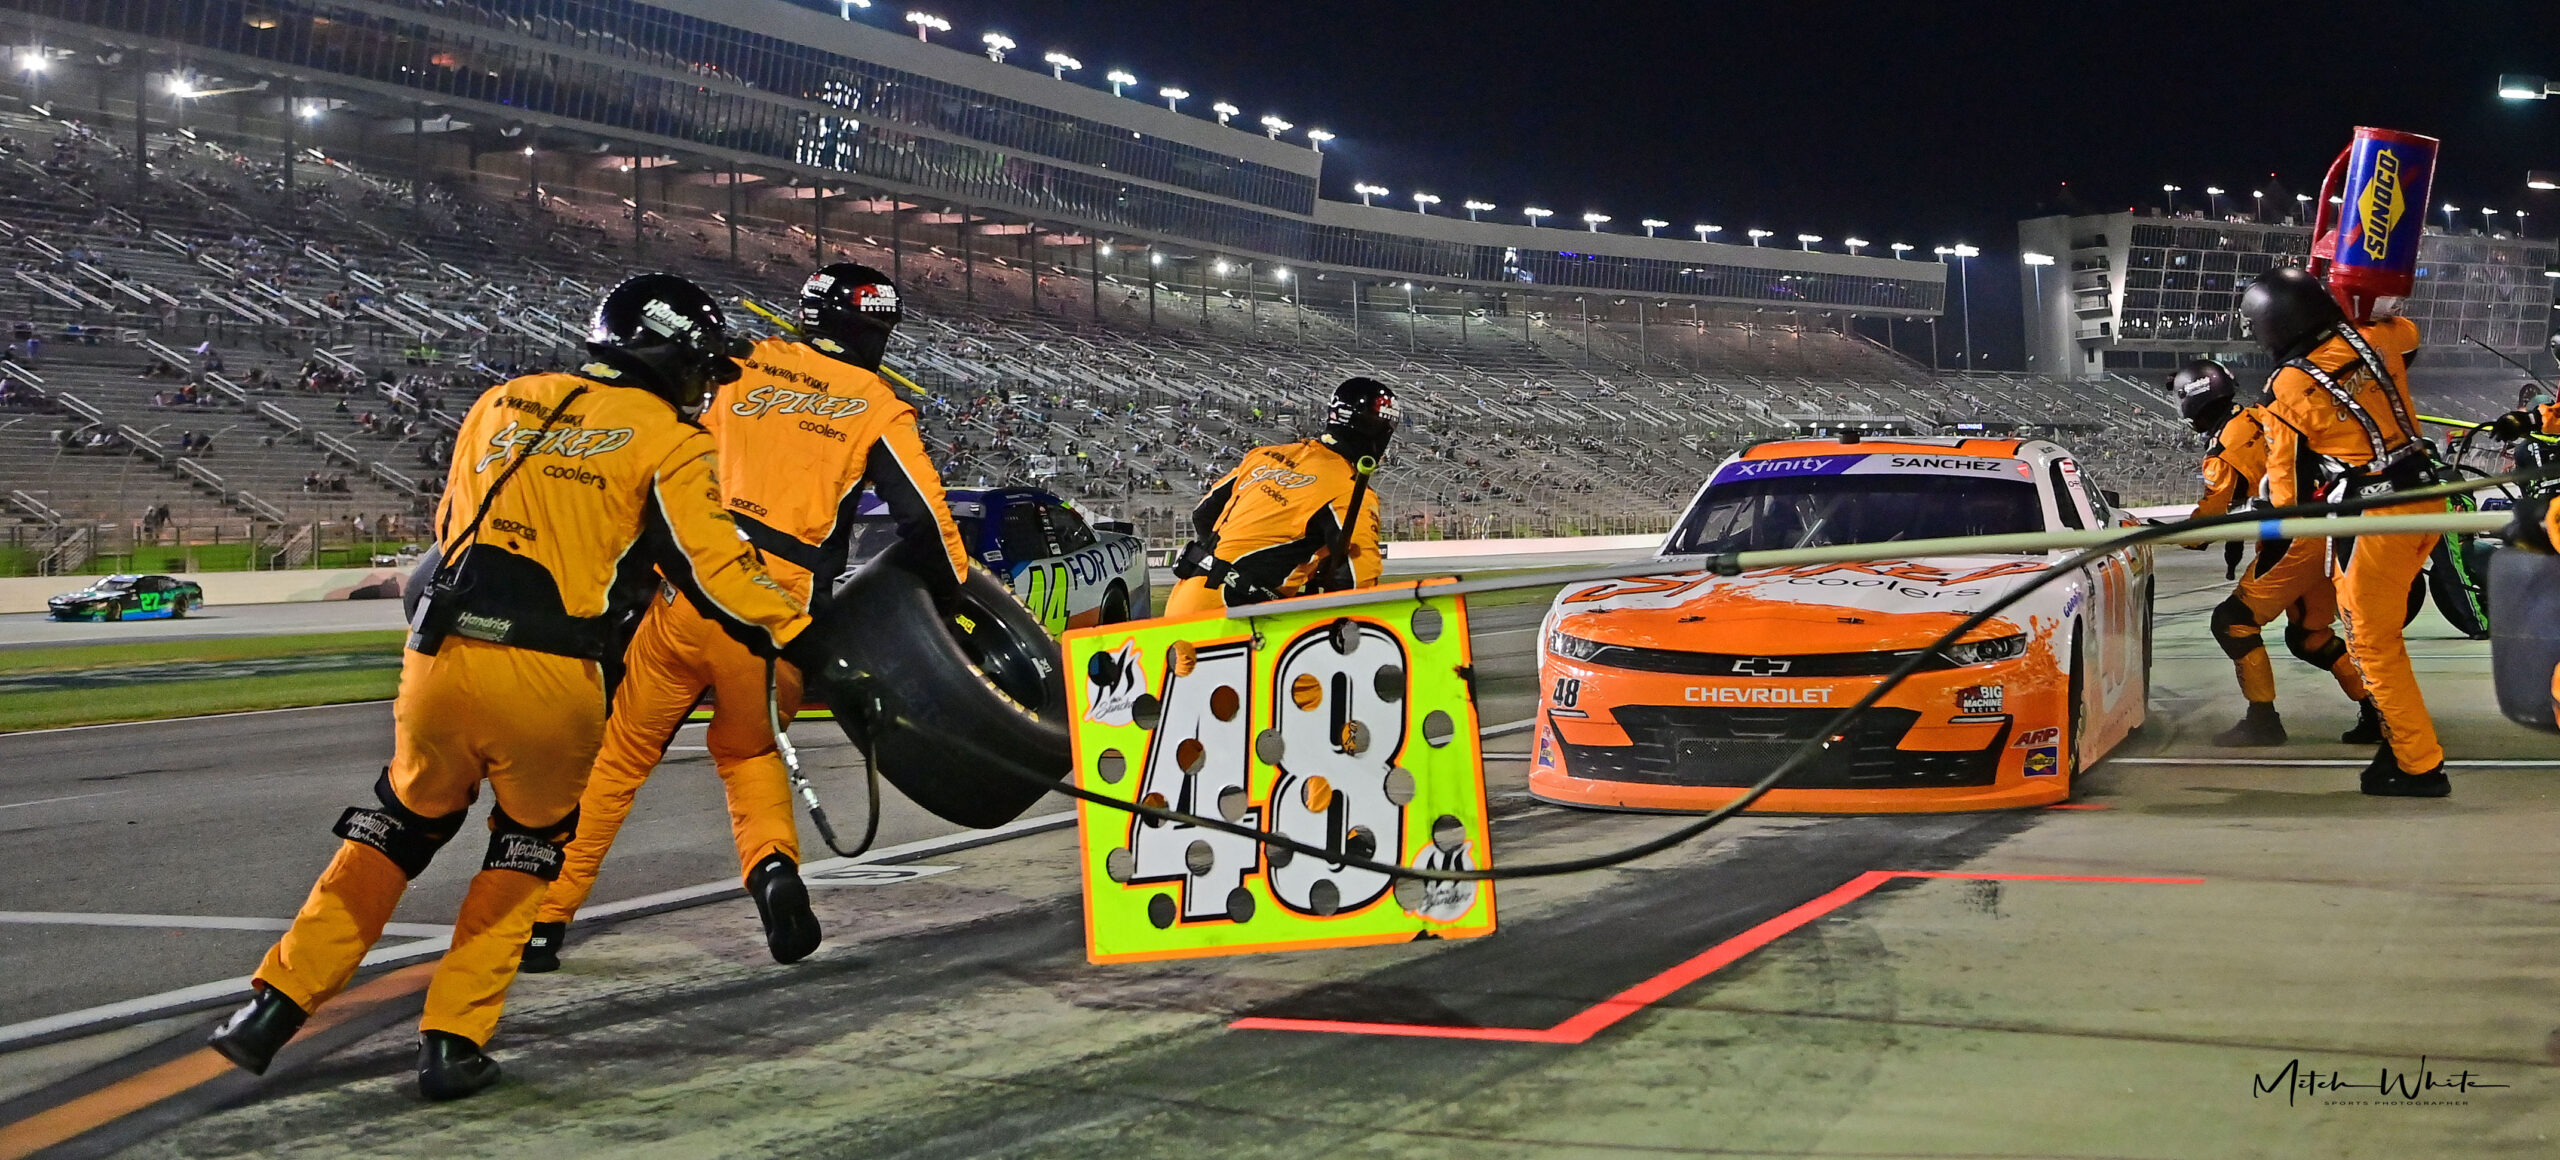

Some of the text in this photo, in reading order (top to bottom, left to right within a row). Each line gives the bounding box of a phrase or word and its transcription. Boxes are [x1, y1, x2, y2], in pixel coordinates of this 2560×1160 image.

[2366, 153, 2398, 256] SUNOCO
[860, 297, 897, 307] MACHINE
[876, 283, 897, 298] BIG
[731, 385, 869, 420] SPIKED
[798, 420, 848, 443] coolers
[543, 465, 607, 490] coolers
[1735, 456, 2002, 477] xfinity SANCHEZ
[1260, 484, 1289, 507] coolers
[729, 497, 768, 518] sparco
[1063, 549, 1108, 591] FOR
[1026, 562, 1070, 636] 44
[1787, 577, 1982, 599] coolers
[140, 592, 160, 611] 27
[458, 611, 512, 634] Hendrick
[1552, 678, 1581, 708] 48
[1684, 686, 1834, 703] CHEVROLET
[1963, 698, 2003, 708] MACHINE
[1980, 685, 2003, 699] BIG
[2012, 727, 2059, 747] ARP
[1125, 617, 1410, 927] 48
[346, 811, 391, 839] Mechanix
[505, 840, 557, 864] Mechanix
